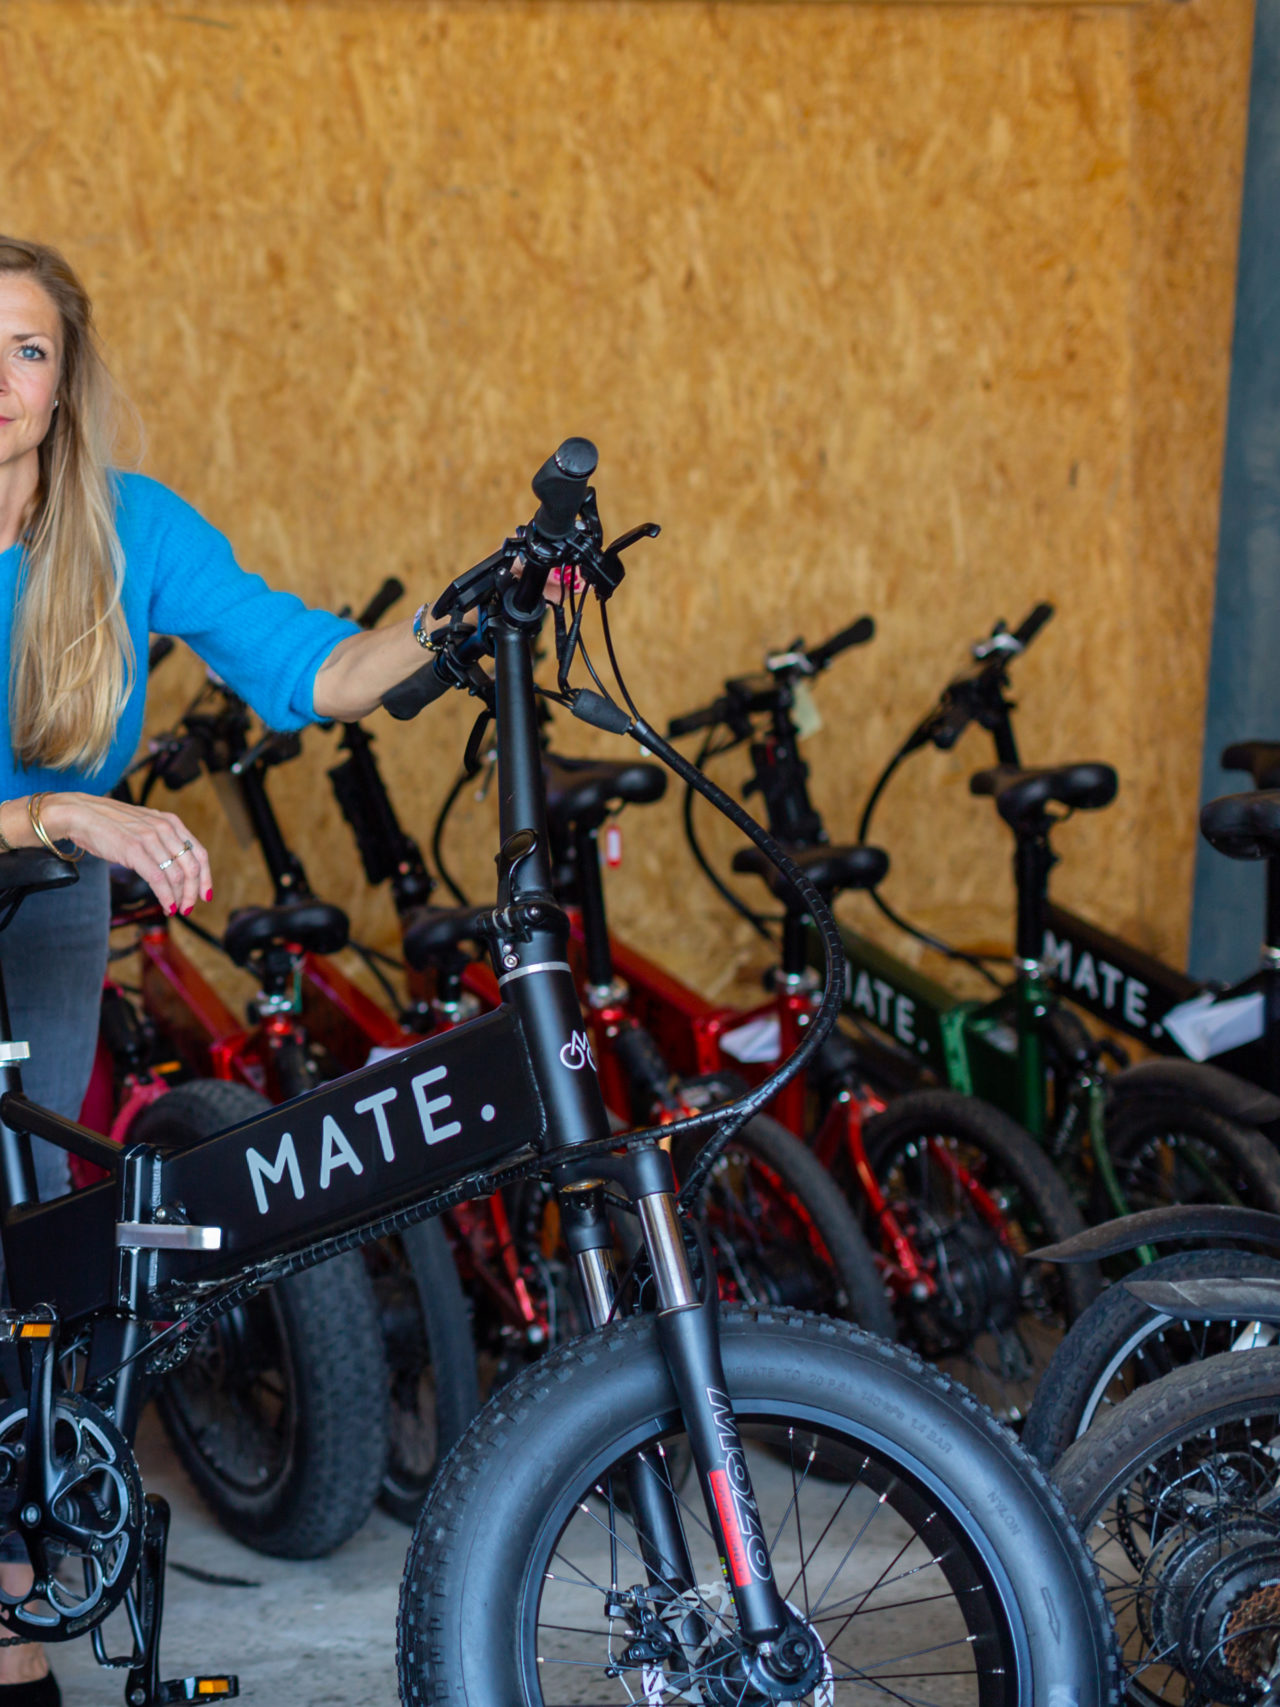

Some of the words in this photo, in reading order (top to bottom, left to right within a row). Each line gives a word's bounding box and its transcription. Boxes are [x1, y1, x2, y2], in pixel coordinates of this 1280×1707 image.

[1043, 930, 1163, 1038] MATE.
[245, 1065, 496, 1214] MATE.
[807, 1372, 825, 1387] 20
[986, 1490, 1023, 1537] NYLON
